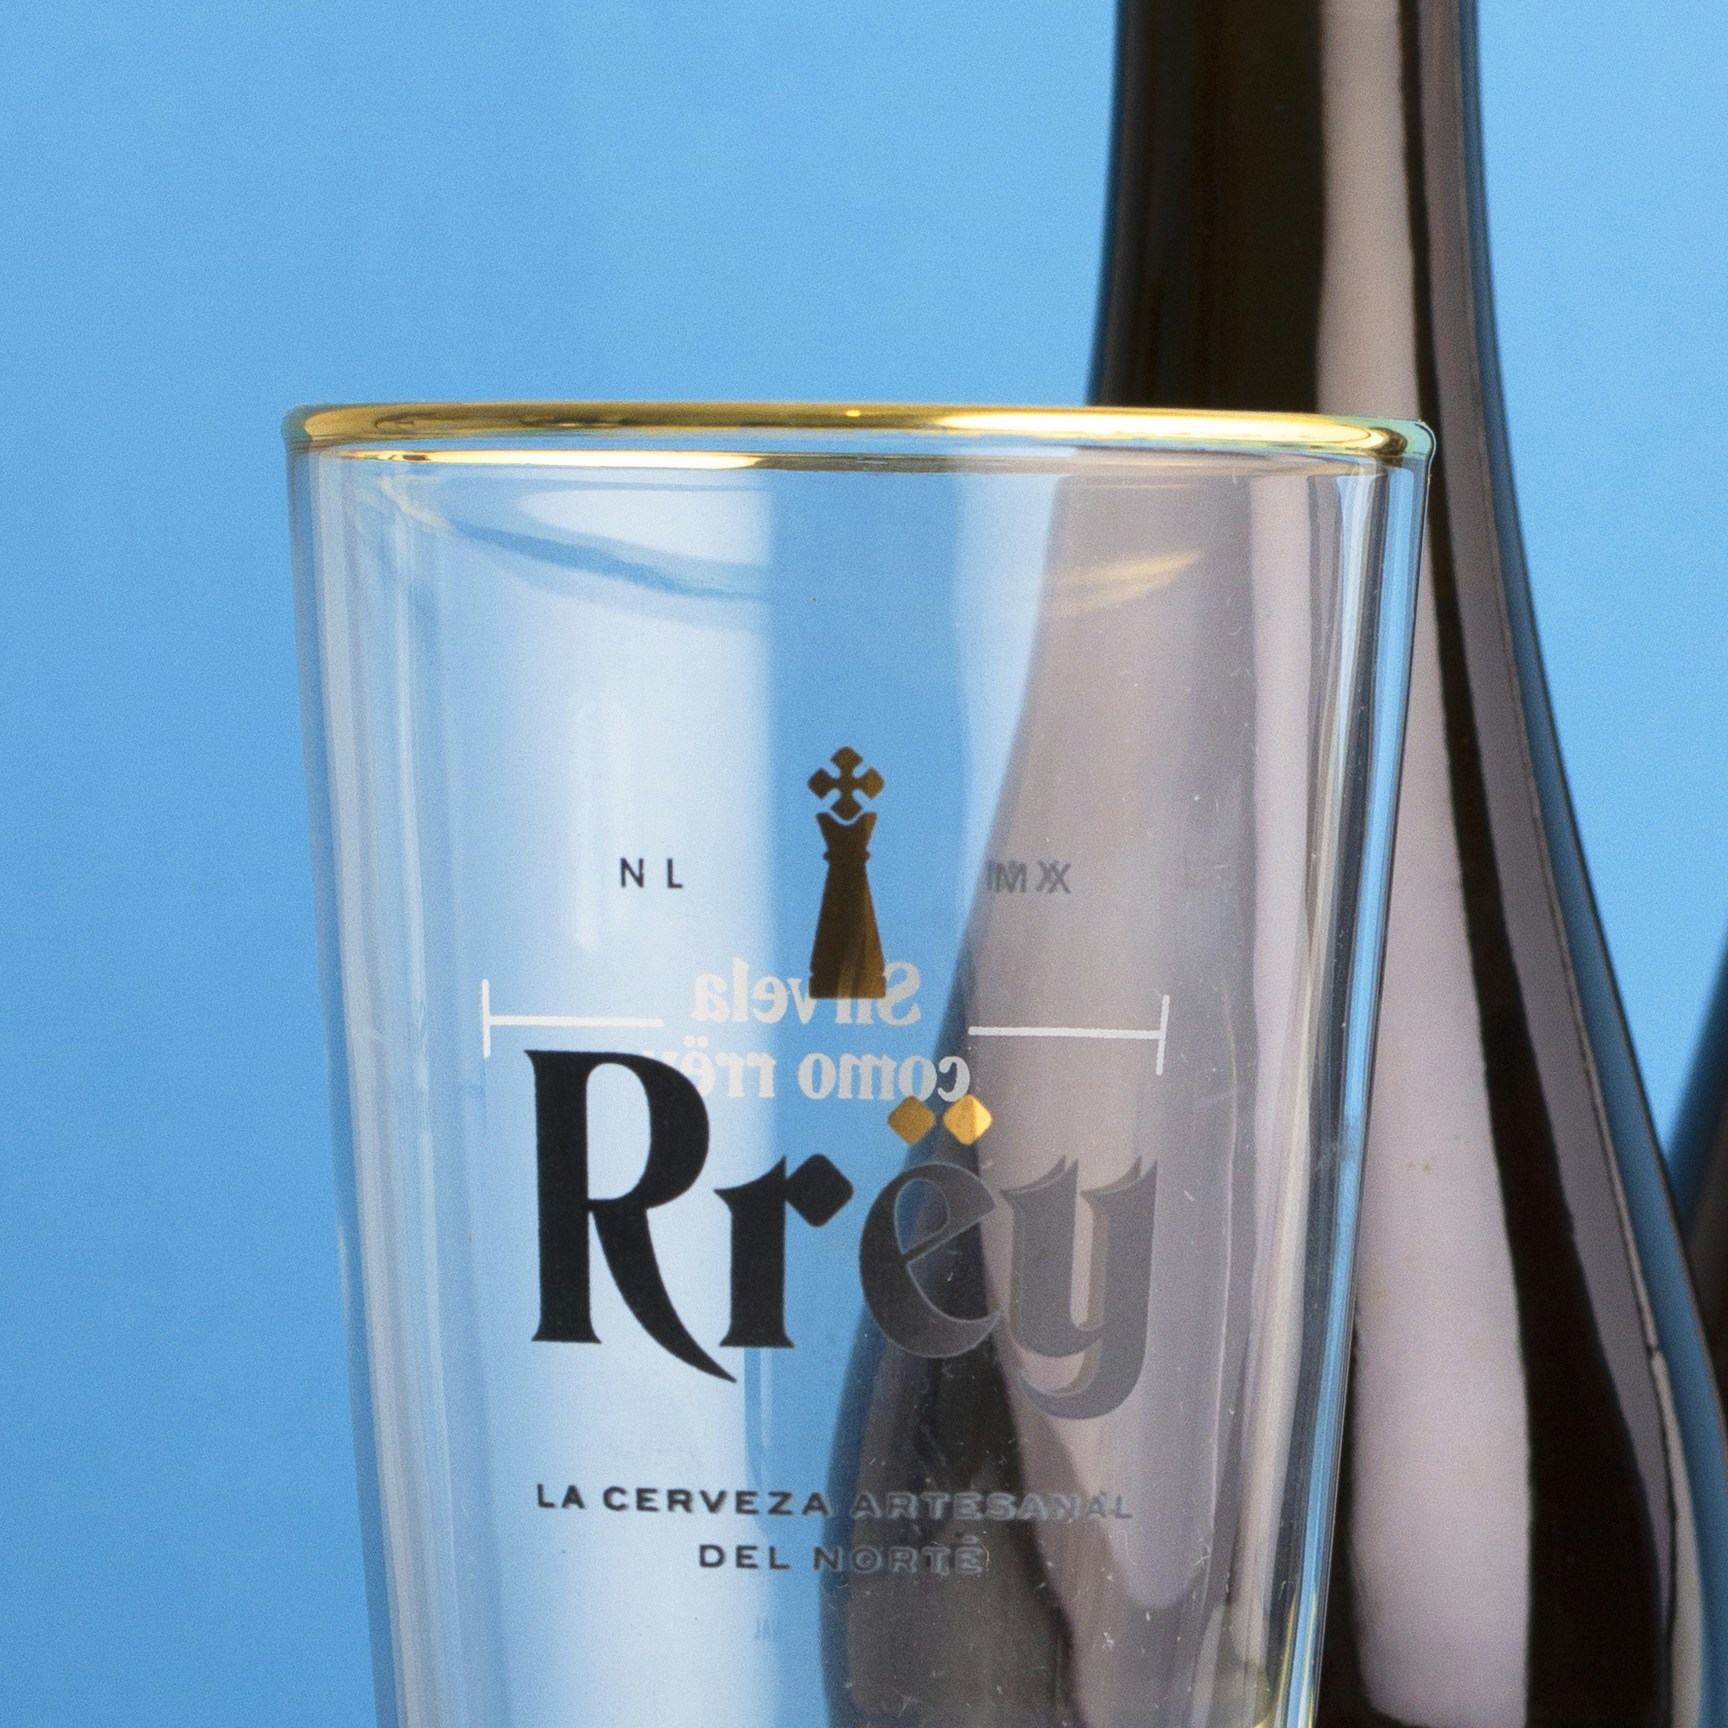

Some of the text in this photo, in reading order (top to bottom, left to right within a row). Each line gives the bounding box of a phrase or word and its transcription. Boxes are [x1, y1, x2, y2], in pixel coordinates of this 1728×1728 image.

[522, 1048, 1160, 1422] Rrëy
[535, 1482, 1134, 1521] LA CERVEZA ARTESANAL
[698, 1543, 792, 1572] DEL
